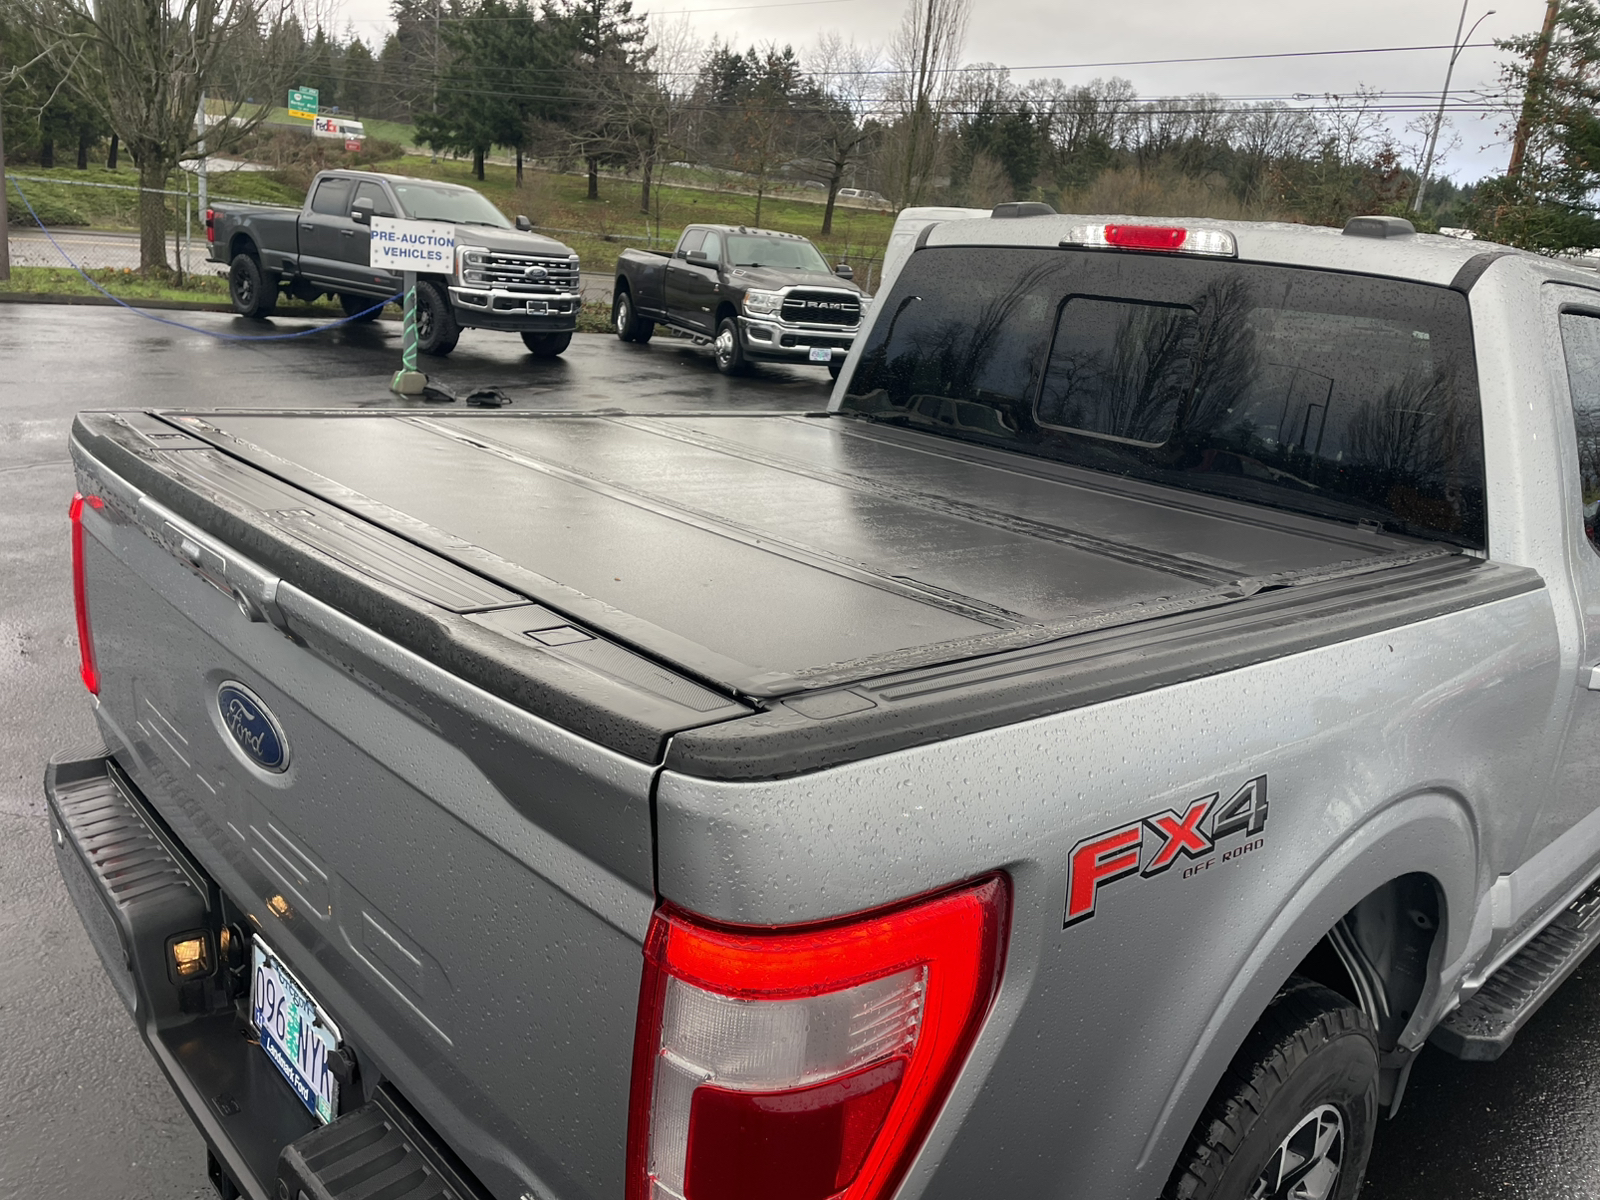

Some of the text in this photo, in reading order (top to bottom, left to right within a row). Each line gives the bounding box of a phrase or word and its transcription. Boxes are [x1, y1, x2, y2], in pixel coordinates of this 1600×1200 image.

[315, 118, 337, 132] FedEx
[370, 230, 455, 247] PRE-AUCTION
[383, 246, 443, 261] VEHICLES
[807, 301, 841, 310] RAM
[227, 698, 265, 756] Ford
[1062, 773, 1269, 931] FX4
[1182, 838, 1265, 880] OFF ROAD
[256, 966, 286, 1041] 096
[266, 1037, 309, 1101] Landmark Ford
